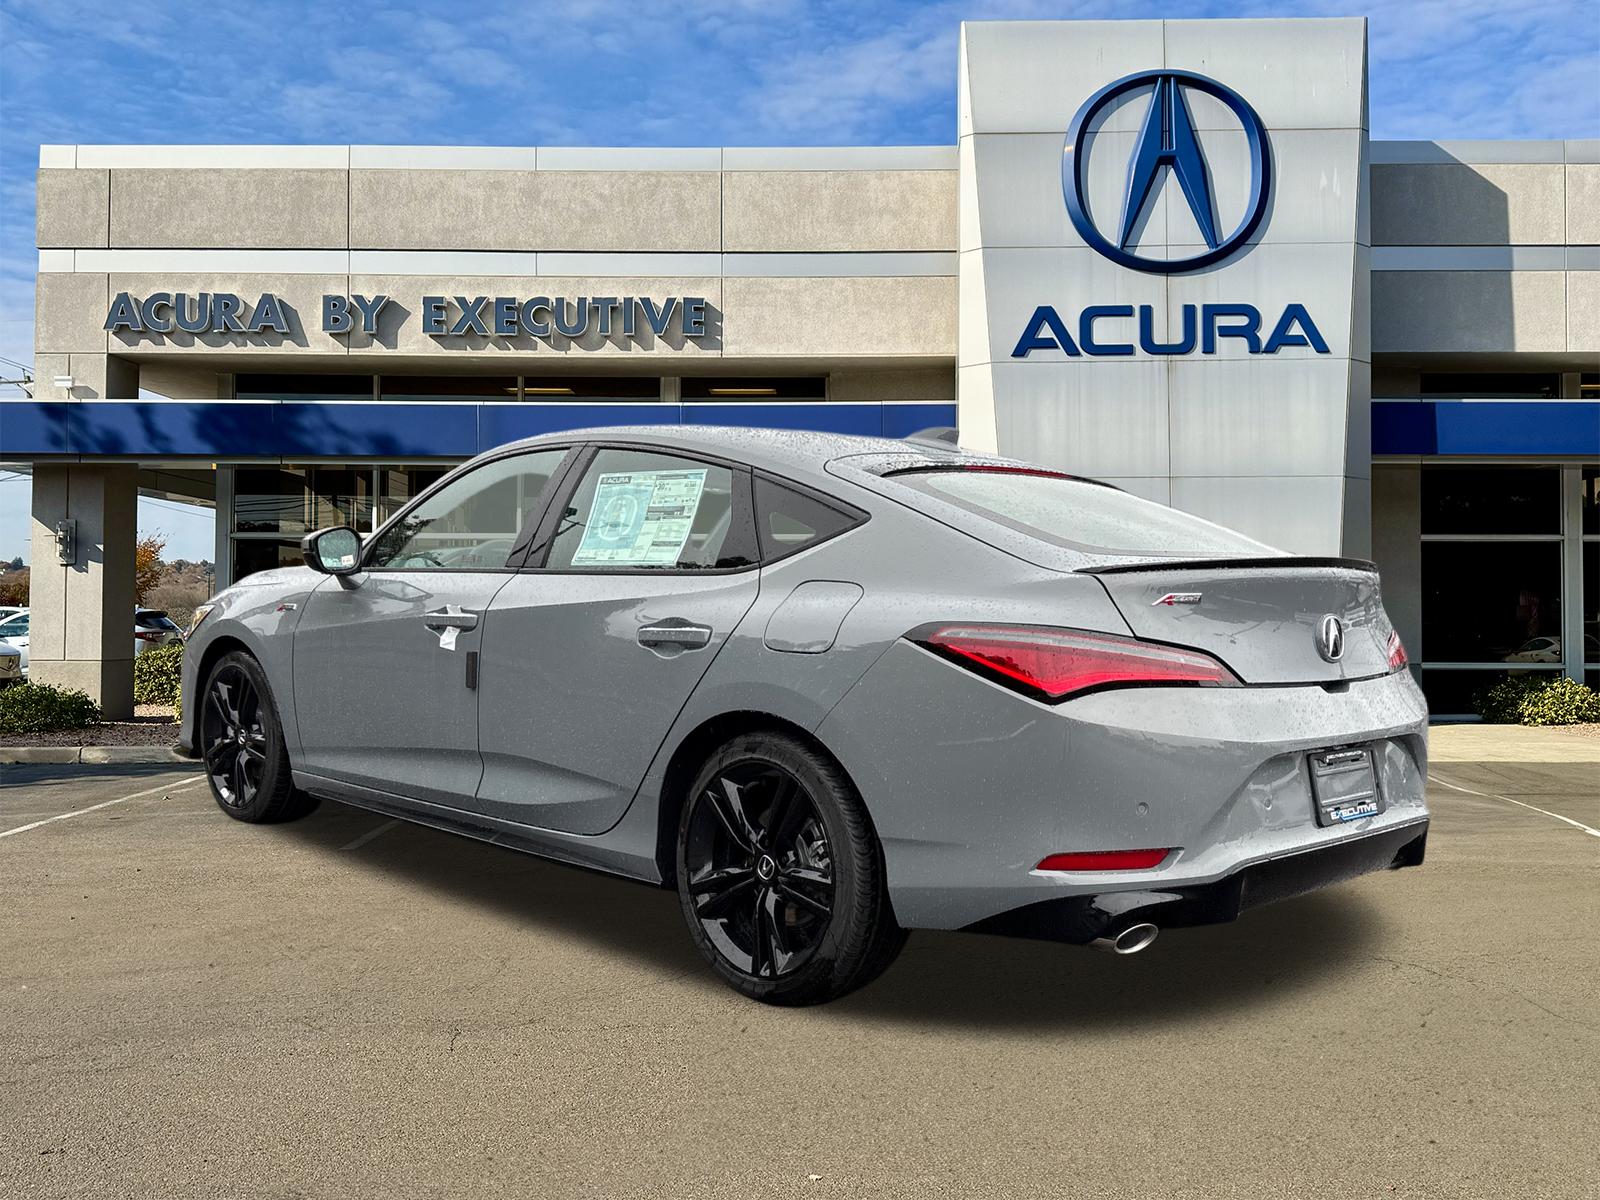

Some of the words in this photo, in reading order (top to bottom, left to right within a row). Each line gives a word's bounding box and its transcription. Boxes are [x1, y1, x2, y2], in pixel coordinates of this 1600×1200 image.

[104, 292, 289, 333] ACURA
[322, 294, 390, 334] BY
[422, 296, 706, 336] EXECUTIVE
[1011, 303, 1331, 357] ACURA
[1330, 802, 1378, 820] EXECUTIVE
